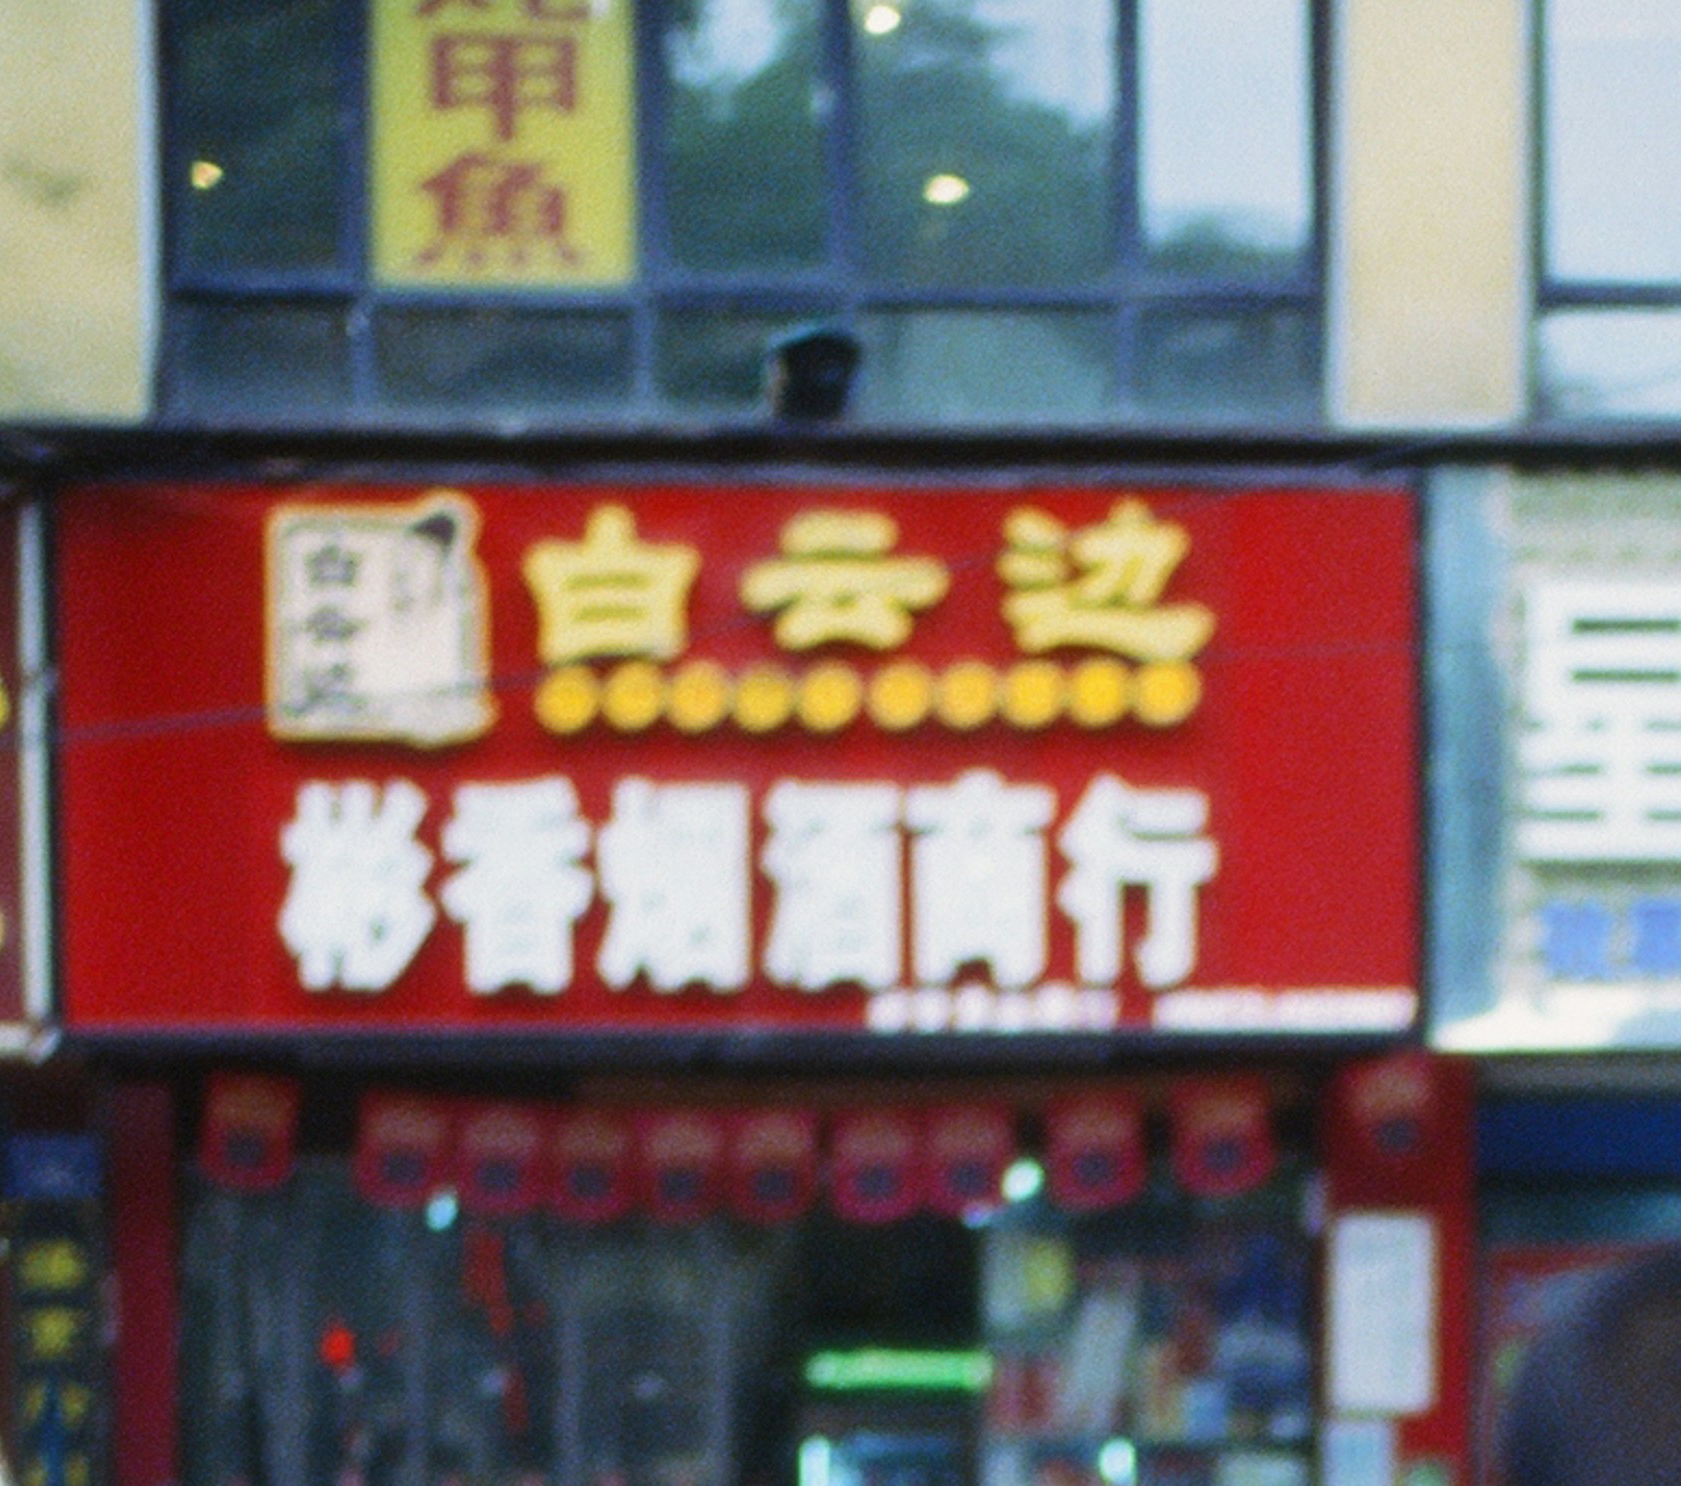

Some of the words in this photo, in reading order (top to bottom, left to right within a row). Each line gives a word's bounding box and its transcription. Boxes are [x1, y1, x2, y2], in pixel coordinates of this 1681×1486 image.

[414, 0, 586, 268] 甲魚
[522, 500, 1218, 666] 白云边
